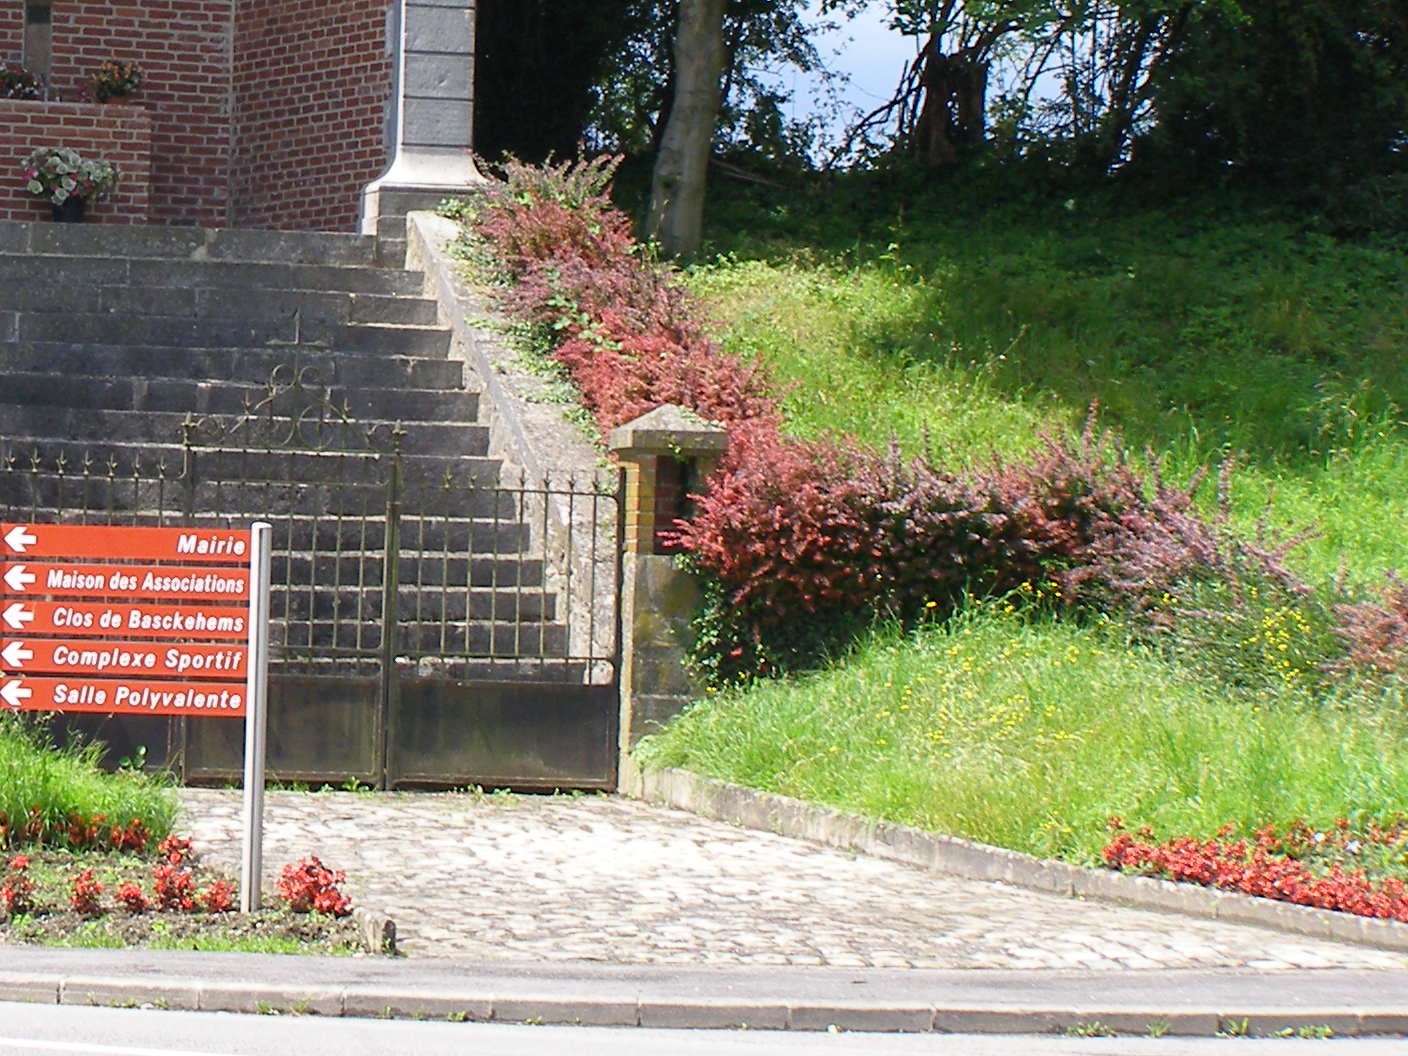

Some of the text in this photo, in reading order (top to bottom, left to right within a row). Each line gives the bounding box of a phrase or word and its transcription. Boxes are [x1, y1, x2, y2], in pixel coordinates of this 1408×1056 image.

[177, 535, 246, 556] Mairie
[47, 569, 244, 594] Maison des Associations
[52, 607, 244, 633] Clos de Basckehems
[53, 646, 243, 673] Complexe Sportif
[53, 684, 242, 711] Salle Polyvalente
